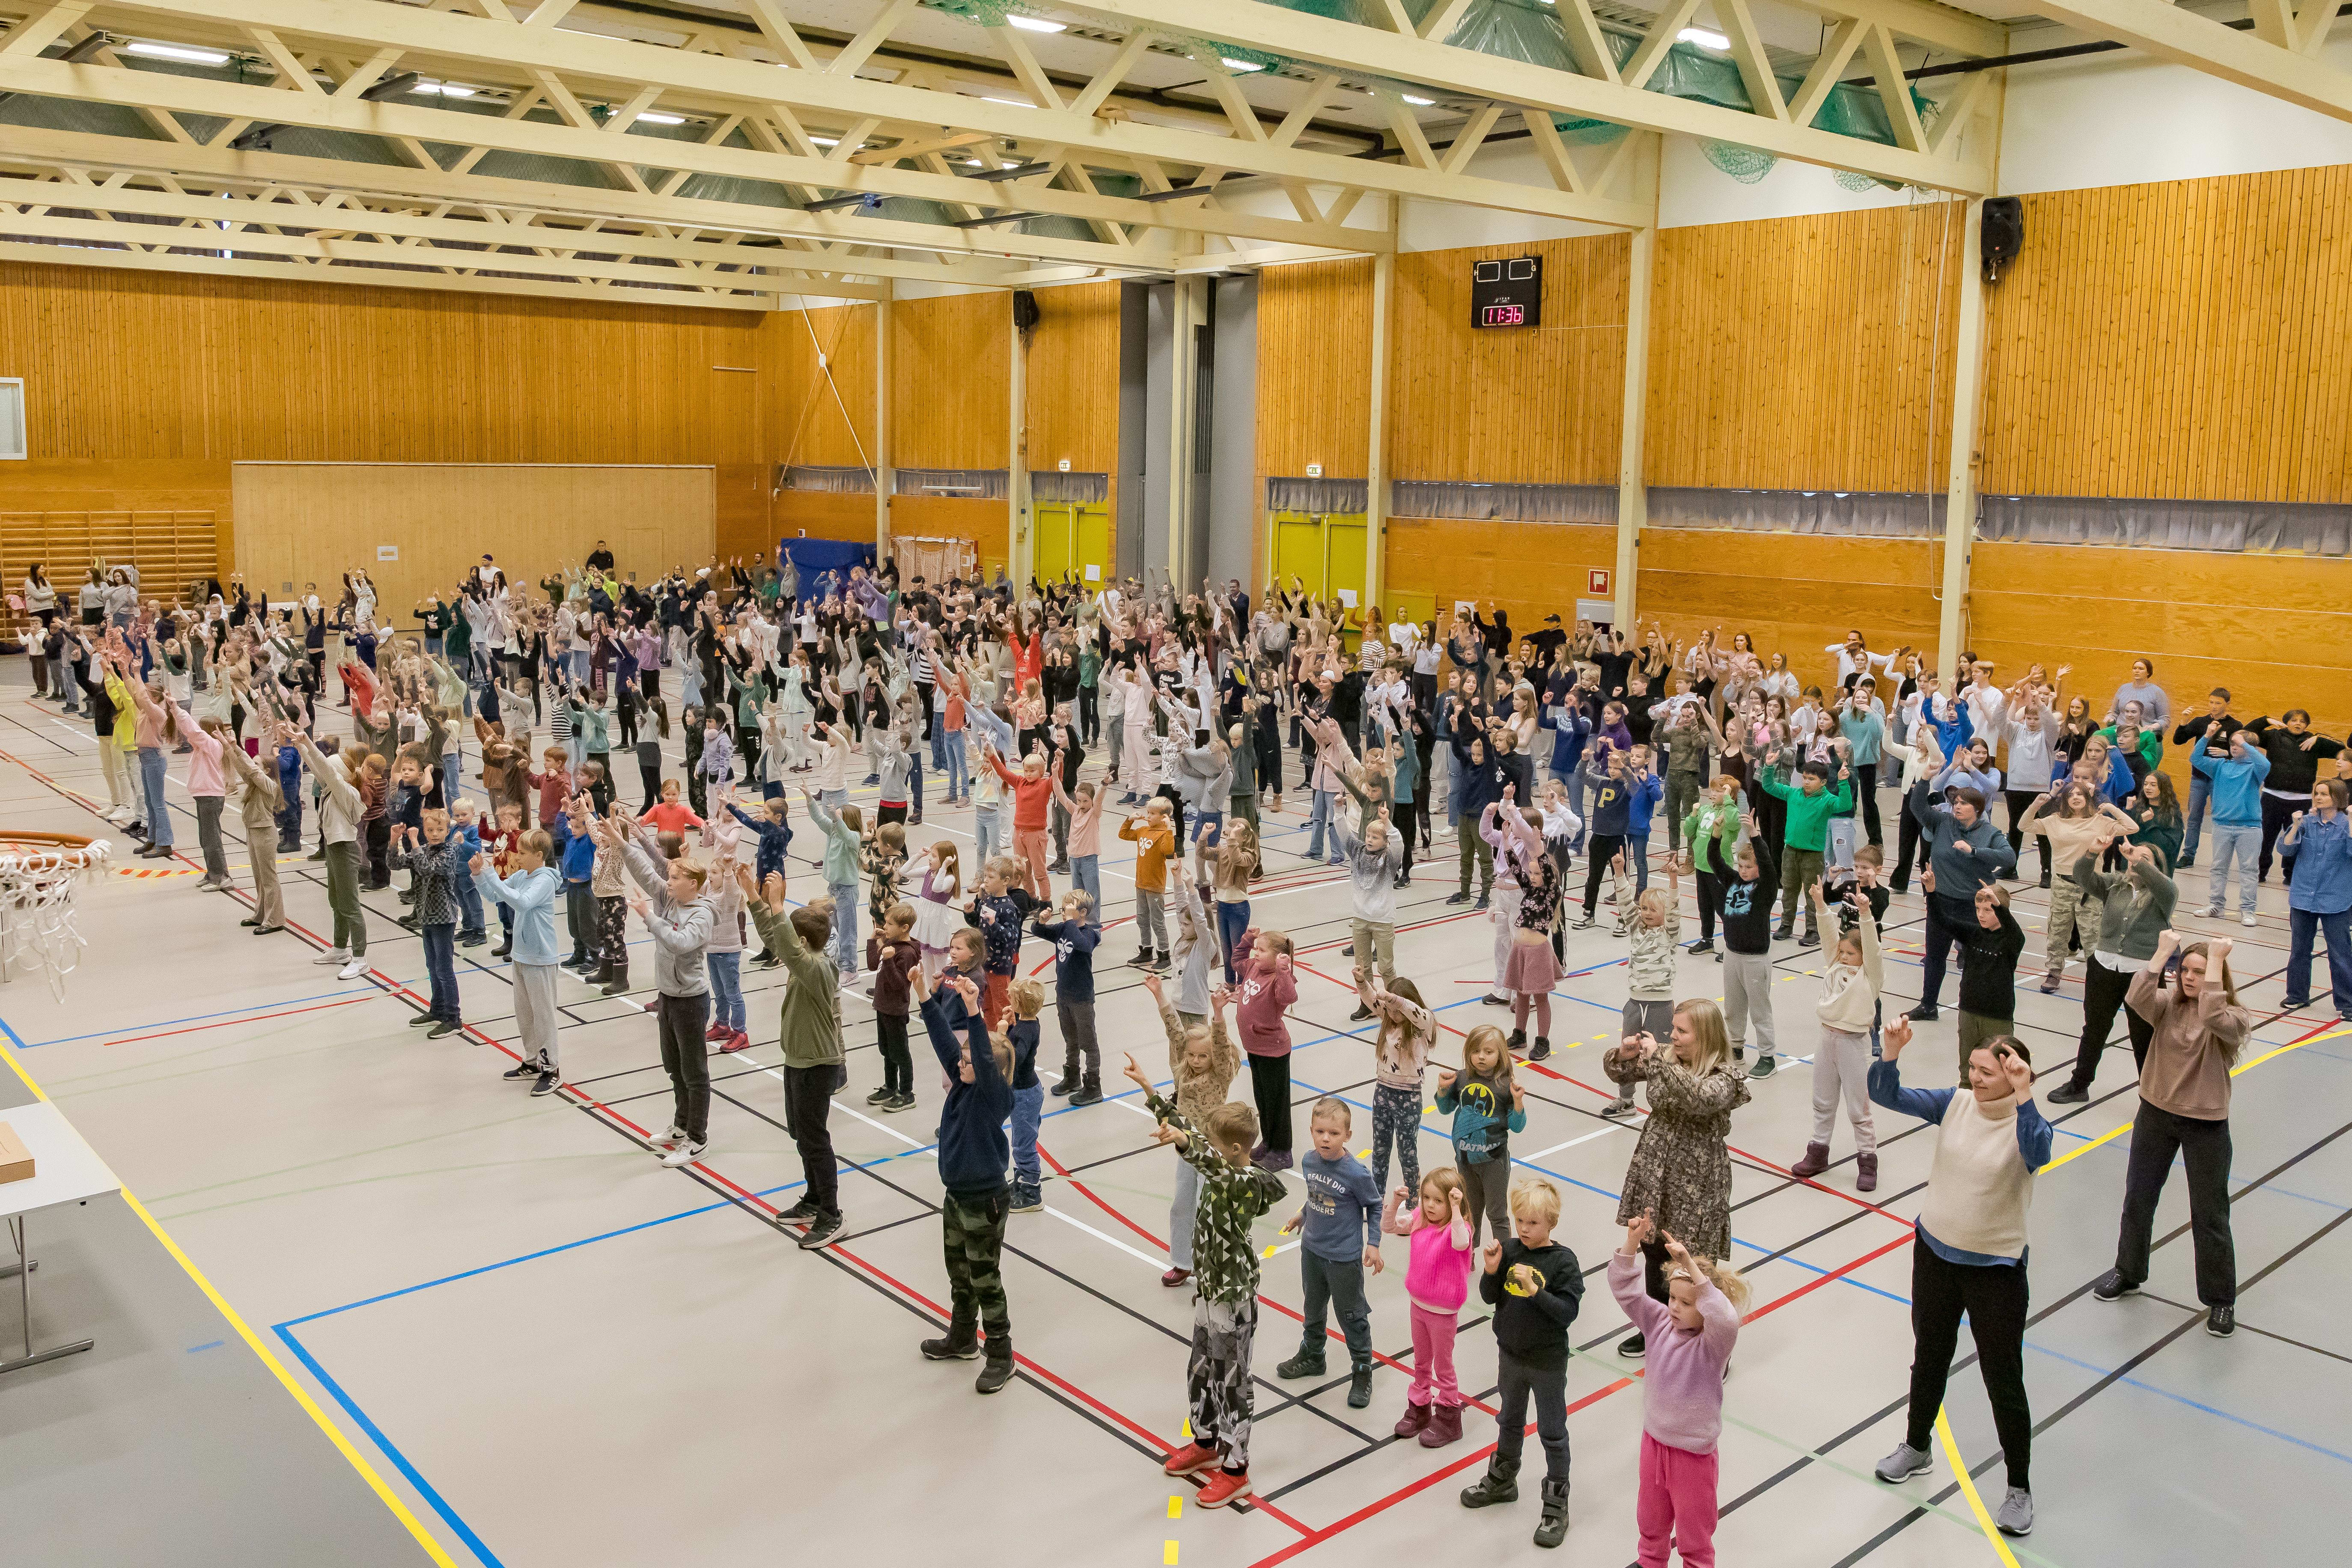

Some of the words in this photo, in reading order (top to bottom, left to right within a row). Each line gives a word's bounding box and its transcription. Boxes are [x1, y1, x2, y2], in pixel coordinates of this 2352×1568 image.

[1489, 307, 1521, 323] 11:36
[1598, 788, 1615, 808] P
[1307, 1173, 1332, 1185] REALLY
[1331, 1180, 1346, 1193] DIG
